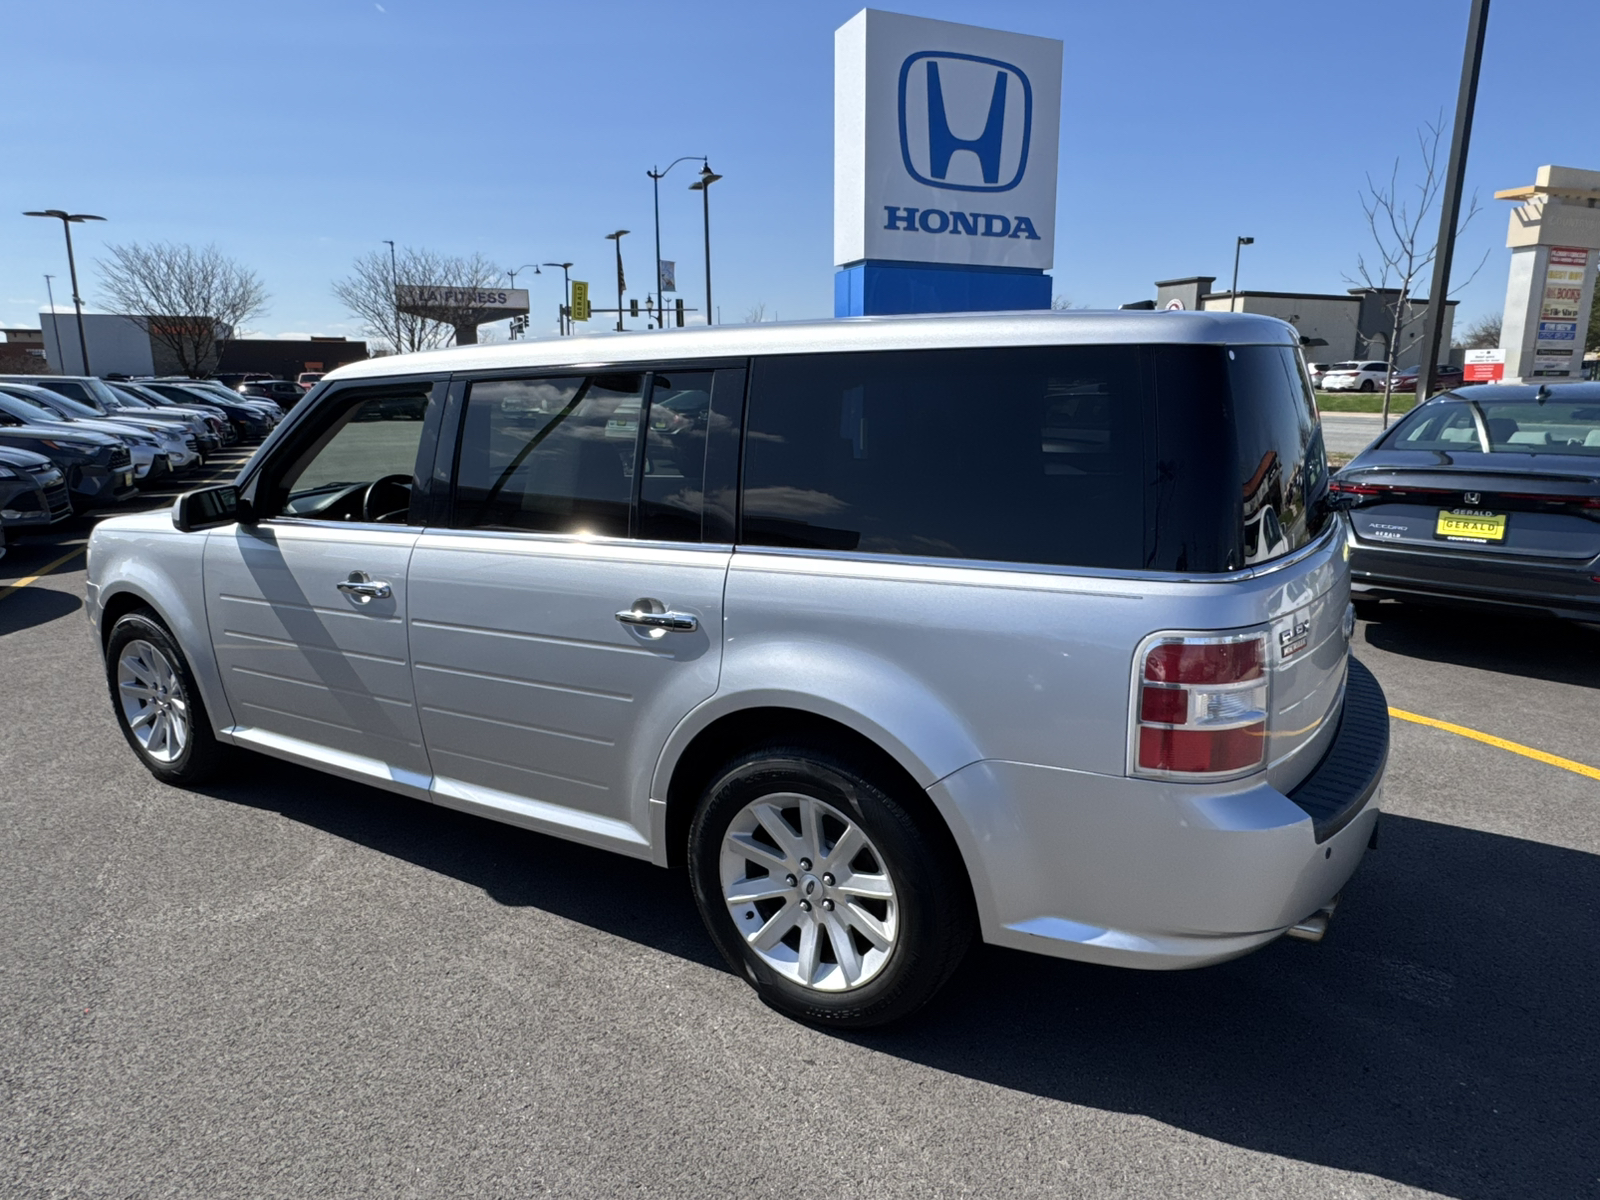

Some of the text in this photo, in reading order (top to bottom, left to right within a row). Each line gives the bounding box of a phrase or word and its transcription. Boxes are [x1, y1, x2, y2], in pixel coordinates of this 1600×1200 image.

[883, 205, 1041, 240] HONDA
[1547, 270, 1567, 279] BEST
[419, 291, 508, 304] LA FITNESS
[1452, 508, 1493, 517] GERALD
[1369, 523, 1408, 531] ACCORD
[1446, 520, 1495, 531] GERALD
